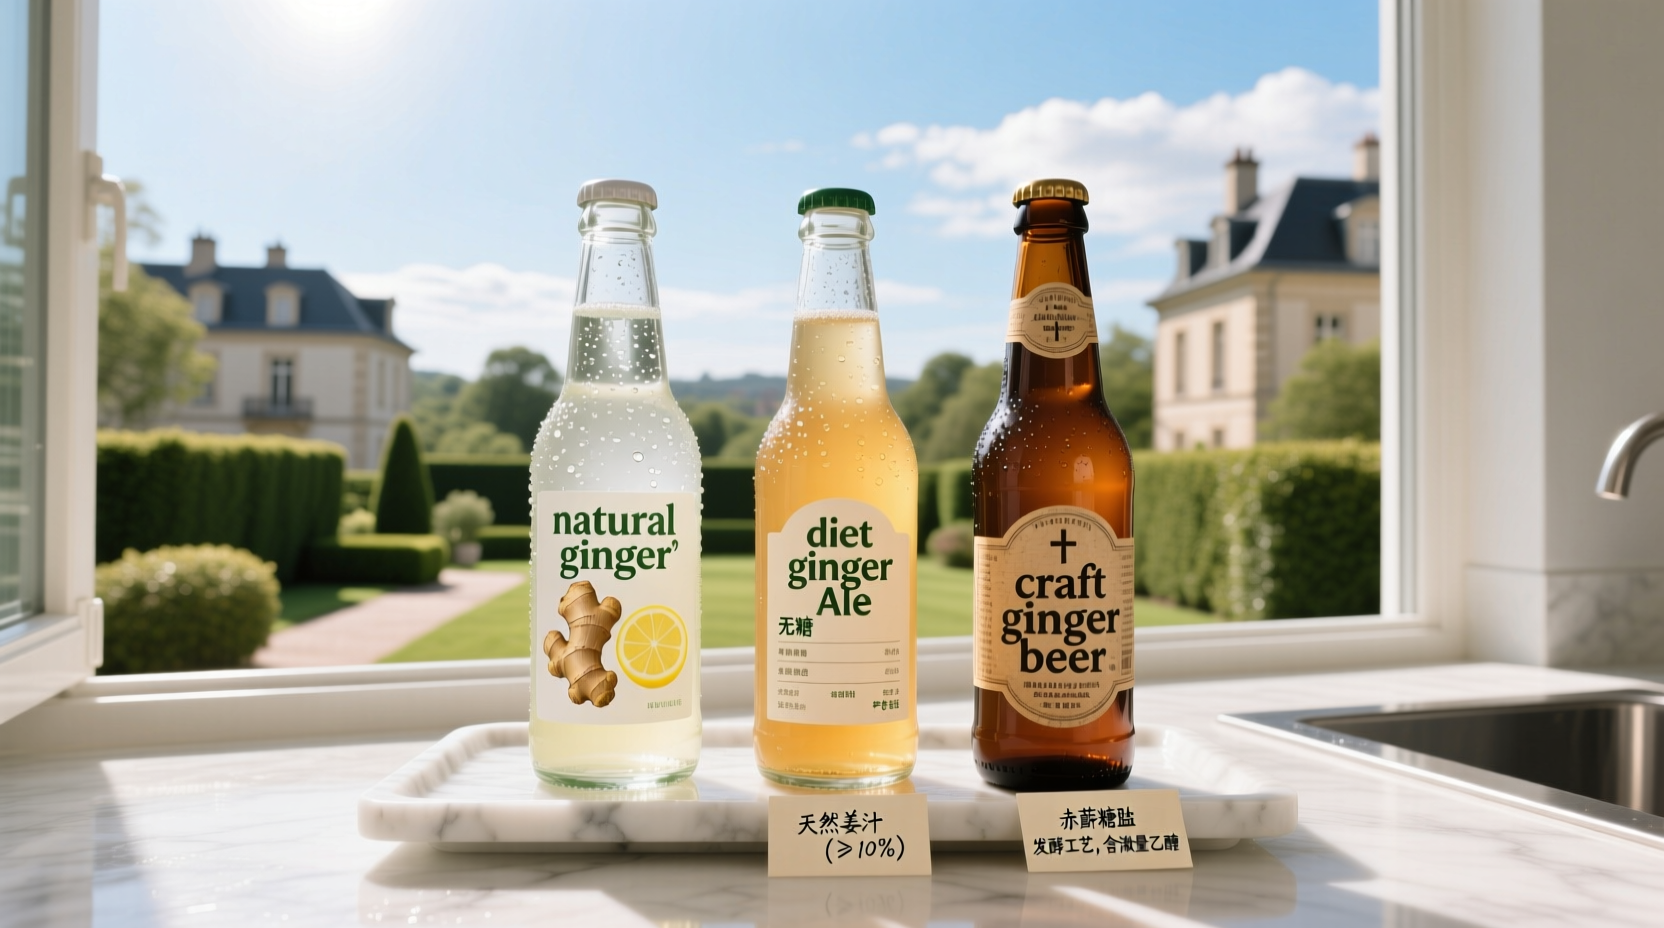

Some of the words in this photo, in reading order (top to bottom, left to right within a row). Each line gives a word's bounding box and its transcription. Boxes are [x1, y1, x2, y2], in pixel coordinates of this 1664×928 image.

[553, 502, 676, 536] natural
[806, 516, 873, 548] diet
[787, 550, 894, 591] ginger
[1015, 562, 1107, 599] craft
[816, 586, 872, 617] Ale
[778, 615, 814, 638] 无糖
[1001, 601, 1120, 646] ginger
[1020, 637, 1107, 674] beer
[798, 809, 884, 835] 天然姜汁
